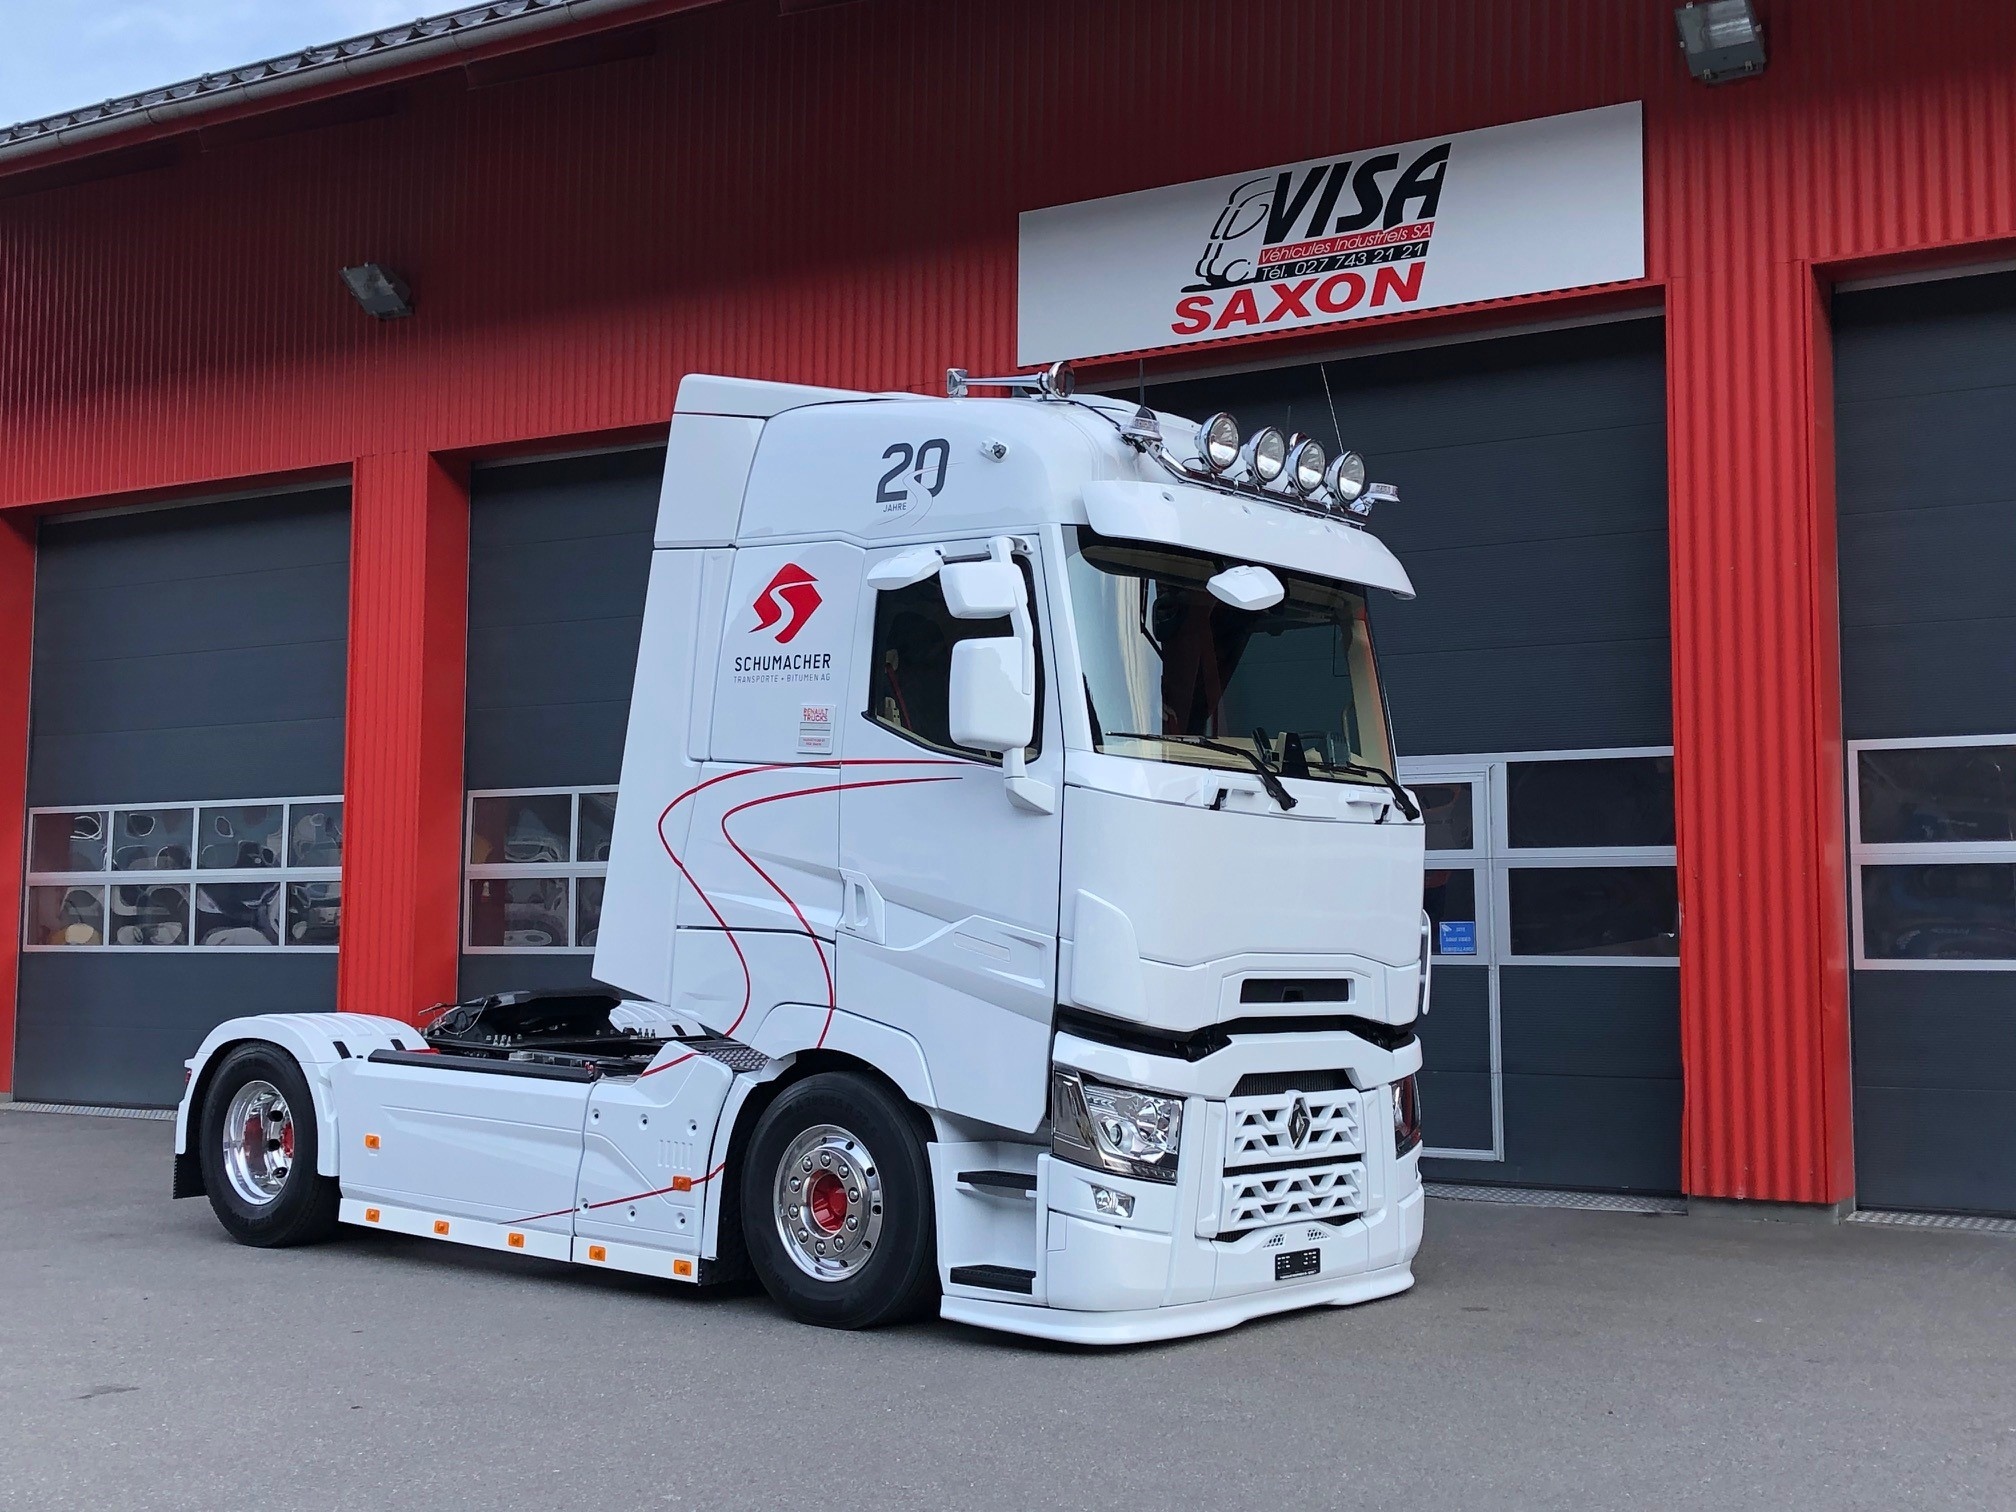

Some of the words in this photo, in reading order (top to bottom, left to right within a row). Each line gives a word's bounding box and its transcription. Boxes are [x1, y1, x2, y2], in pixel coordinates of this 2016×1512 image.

[1263, 142, 1452, 245] VISA
[1261, 242, 1331, 263] Véhicules
[1334, 226, 1408, 252] Industriels
[1411, 223, 1432, 239] SA
[1262, 265, 1288, 281] Tél.
[1295, 259, 1329, 275] 027
[1336, 252, 1367, 269] 743
[1373, 248, 1395, 263] 21
[1400, 243, 1423, 259] 21
[1171, 261, 1426, 335] SAXON
[876, 438, 950, 503] 20
[883, 502, 907, 513] JAHRE
[733, 674, 779, 684] TRANSPORTE
[787, 673, 819, 682] BITUMEN
[821, 673, 831, 681] AG
[734, 653, 831, 671] SCHUMACHER
